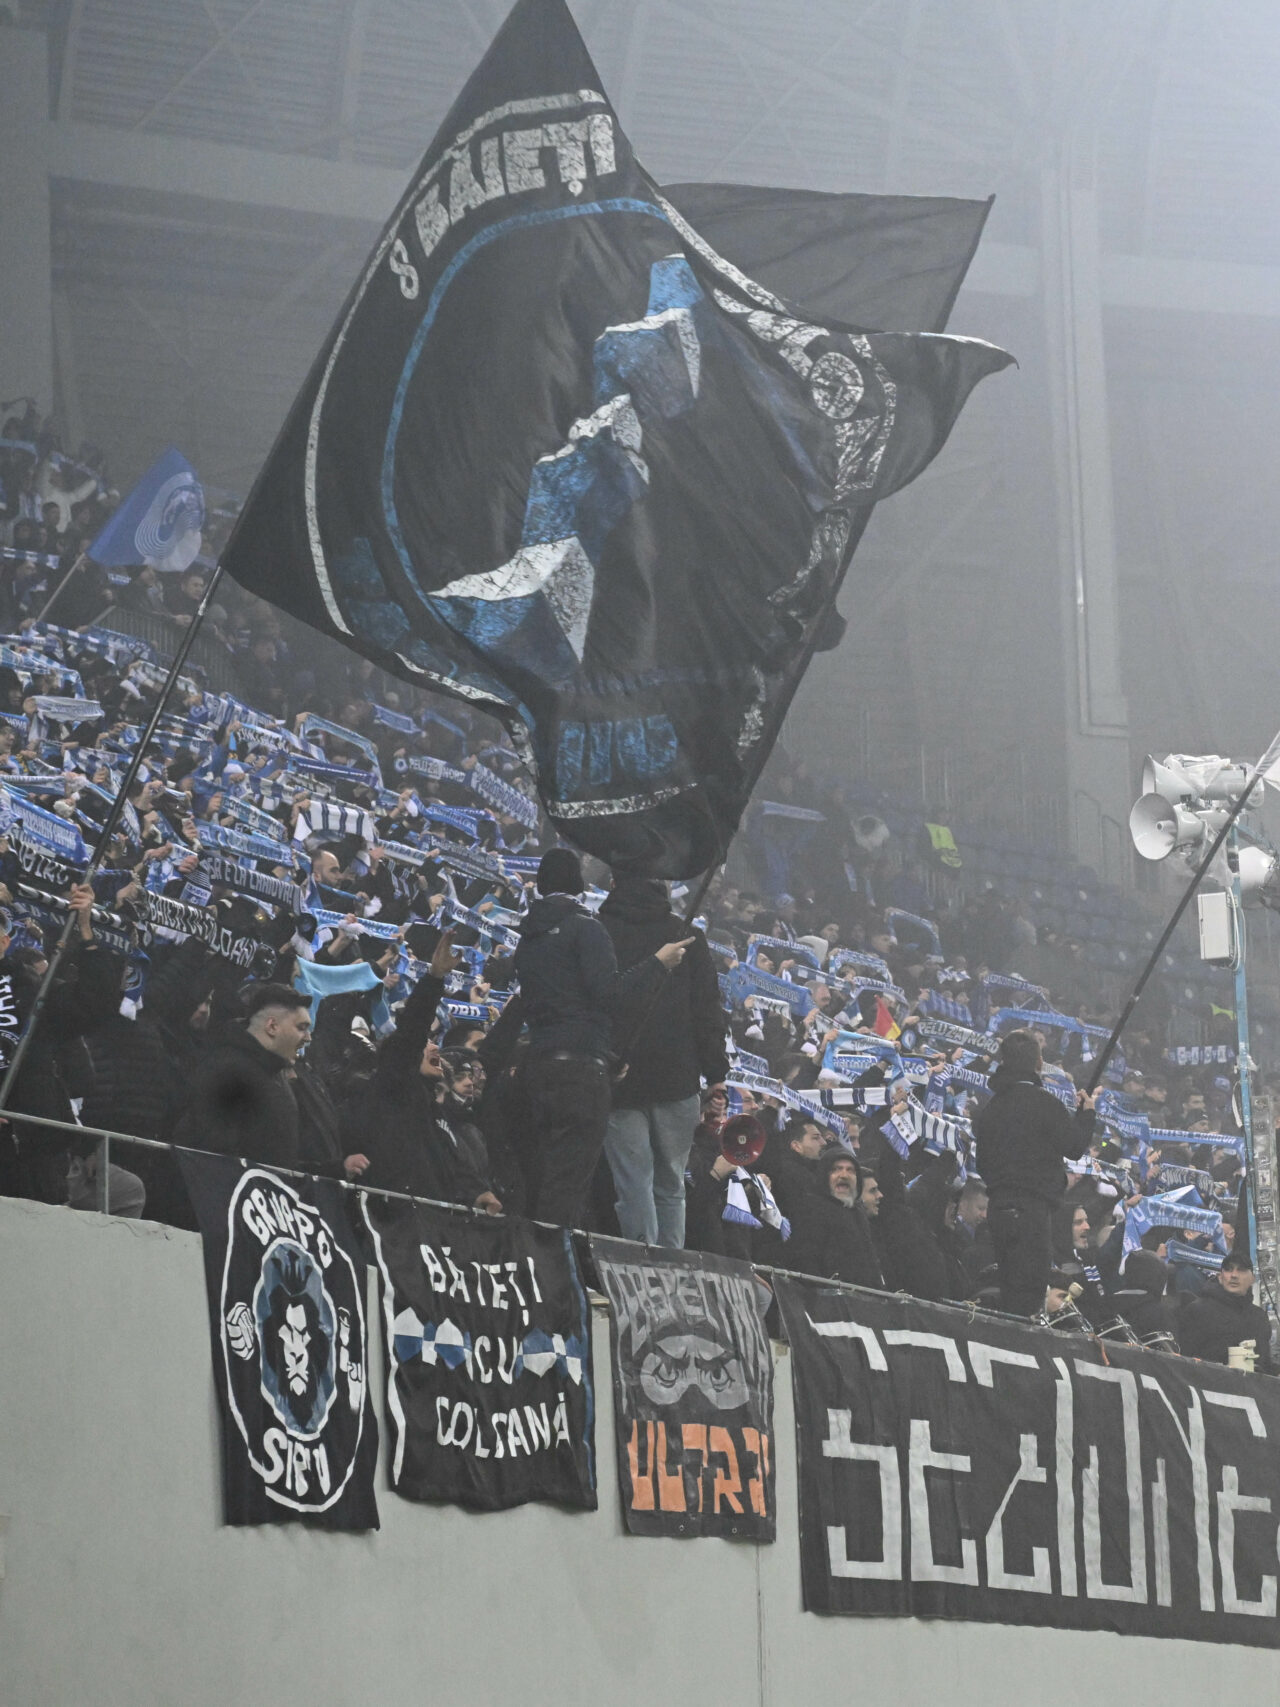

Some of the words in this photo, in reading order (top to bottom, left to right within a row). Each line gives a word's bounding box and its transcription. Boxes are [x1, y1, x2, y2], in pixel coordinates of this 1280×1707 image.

[917, 1020, 964, 1044] PELUZA
[967, 1033, 1000, 1054] NORD
[242, 1187, 333, 1268] GRUPPO
[474, 1335, 518, 1384] CU
[804, 1311, 1279, 1618] SEZIONE
